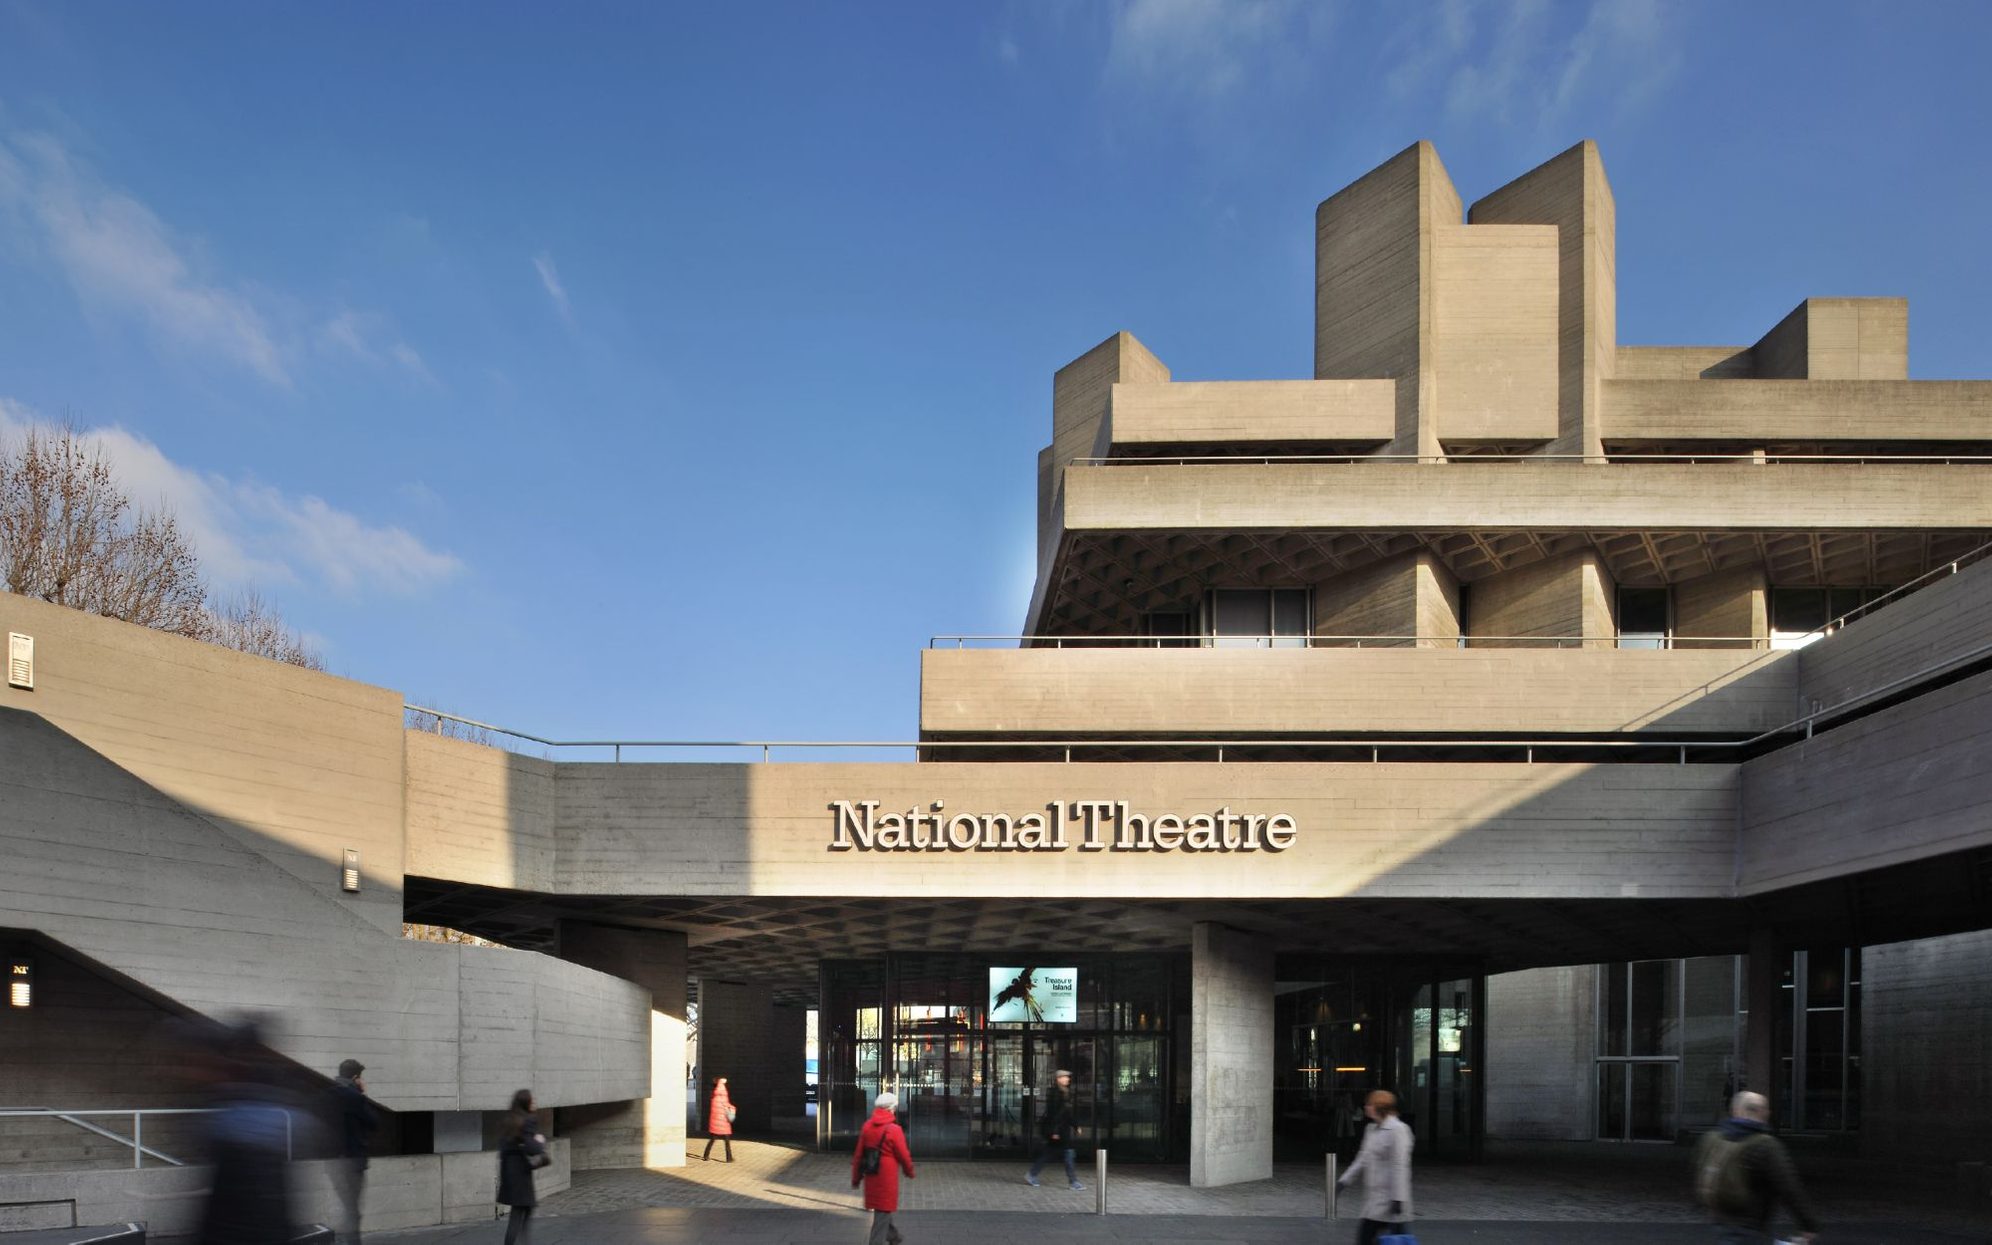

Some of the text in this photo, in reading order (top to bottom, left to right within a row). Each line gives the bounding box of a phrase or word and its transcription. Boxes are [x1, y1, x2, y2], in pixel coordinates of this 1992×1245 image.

[830, 800, 1298, 851] National Theatre
[13, 965, 29, 974] NT
[1045, 976, 1072, 984] Treasure
[1052, 983, 1072, 991] Island
